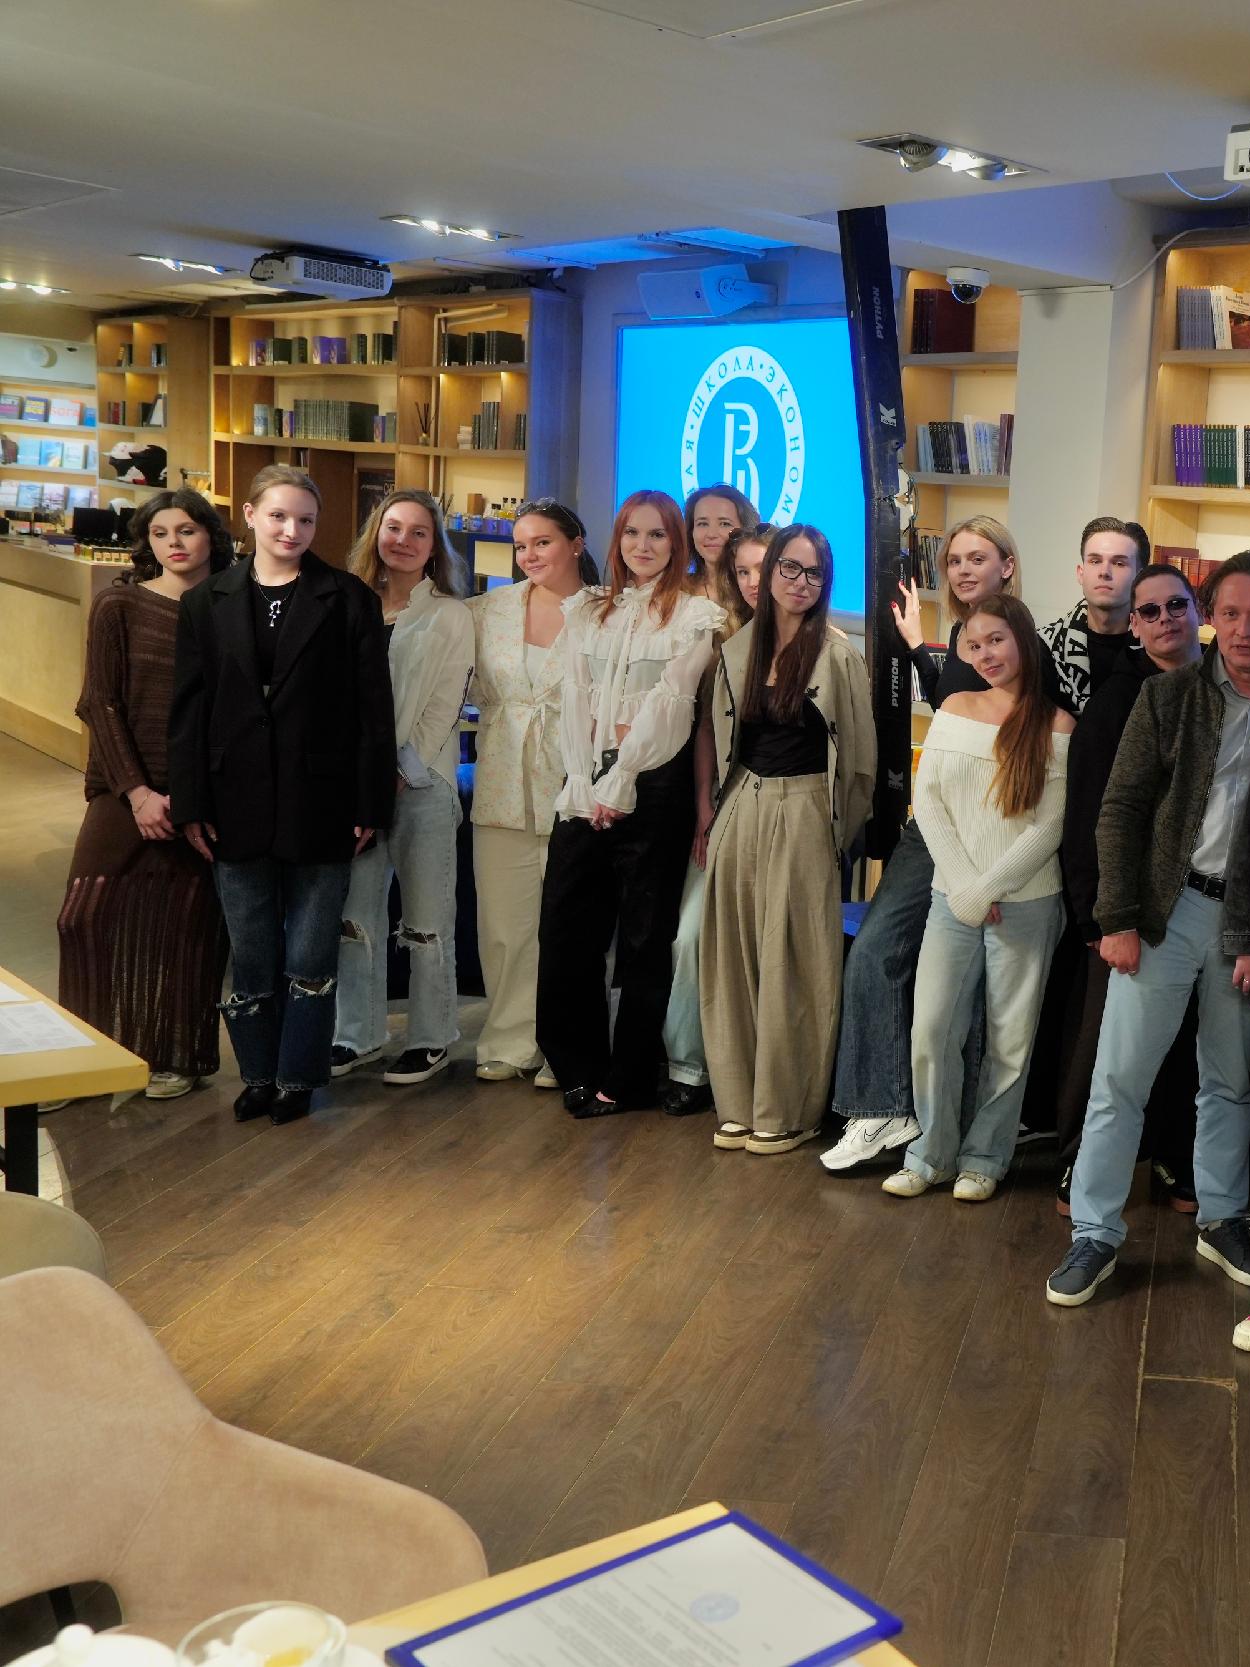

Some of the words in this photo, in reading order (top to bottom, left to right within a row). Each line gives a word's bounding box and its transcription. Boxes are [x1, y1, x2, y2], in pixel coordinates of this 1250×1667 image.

[872, 284, 884, 340] PYTHON
[692, 355, 755, 419] ШКОЛА
[765, 365, 801, 526] ЭКОНОМ
[891, 656, 900, 708] PYTHON
